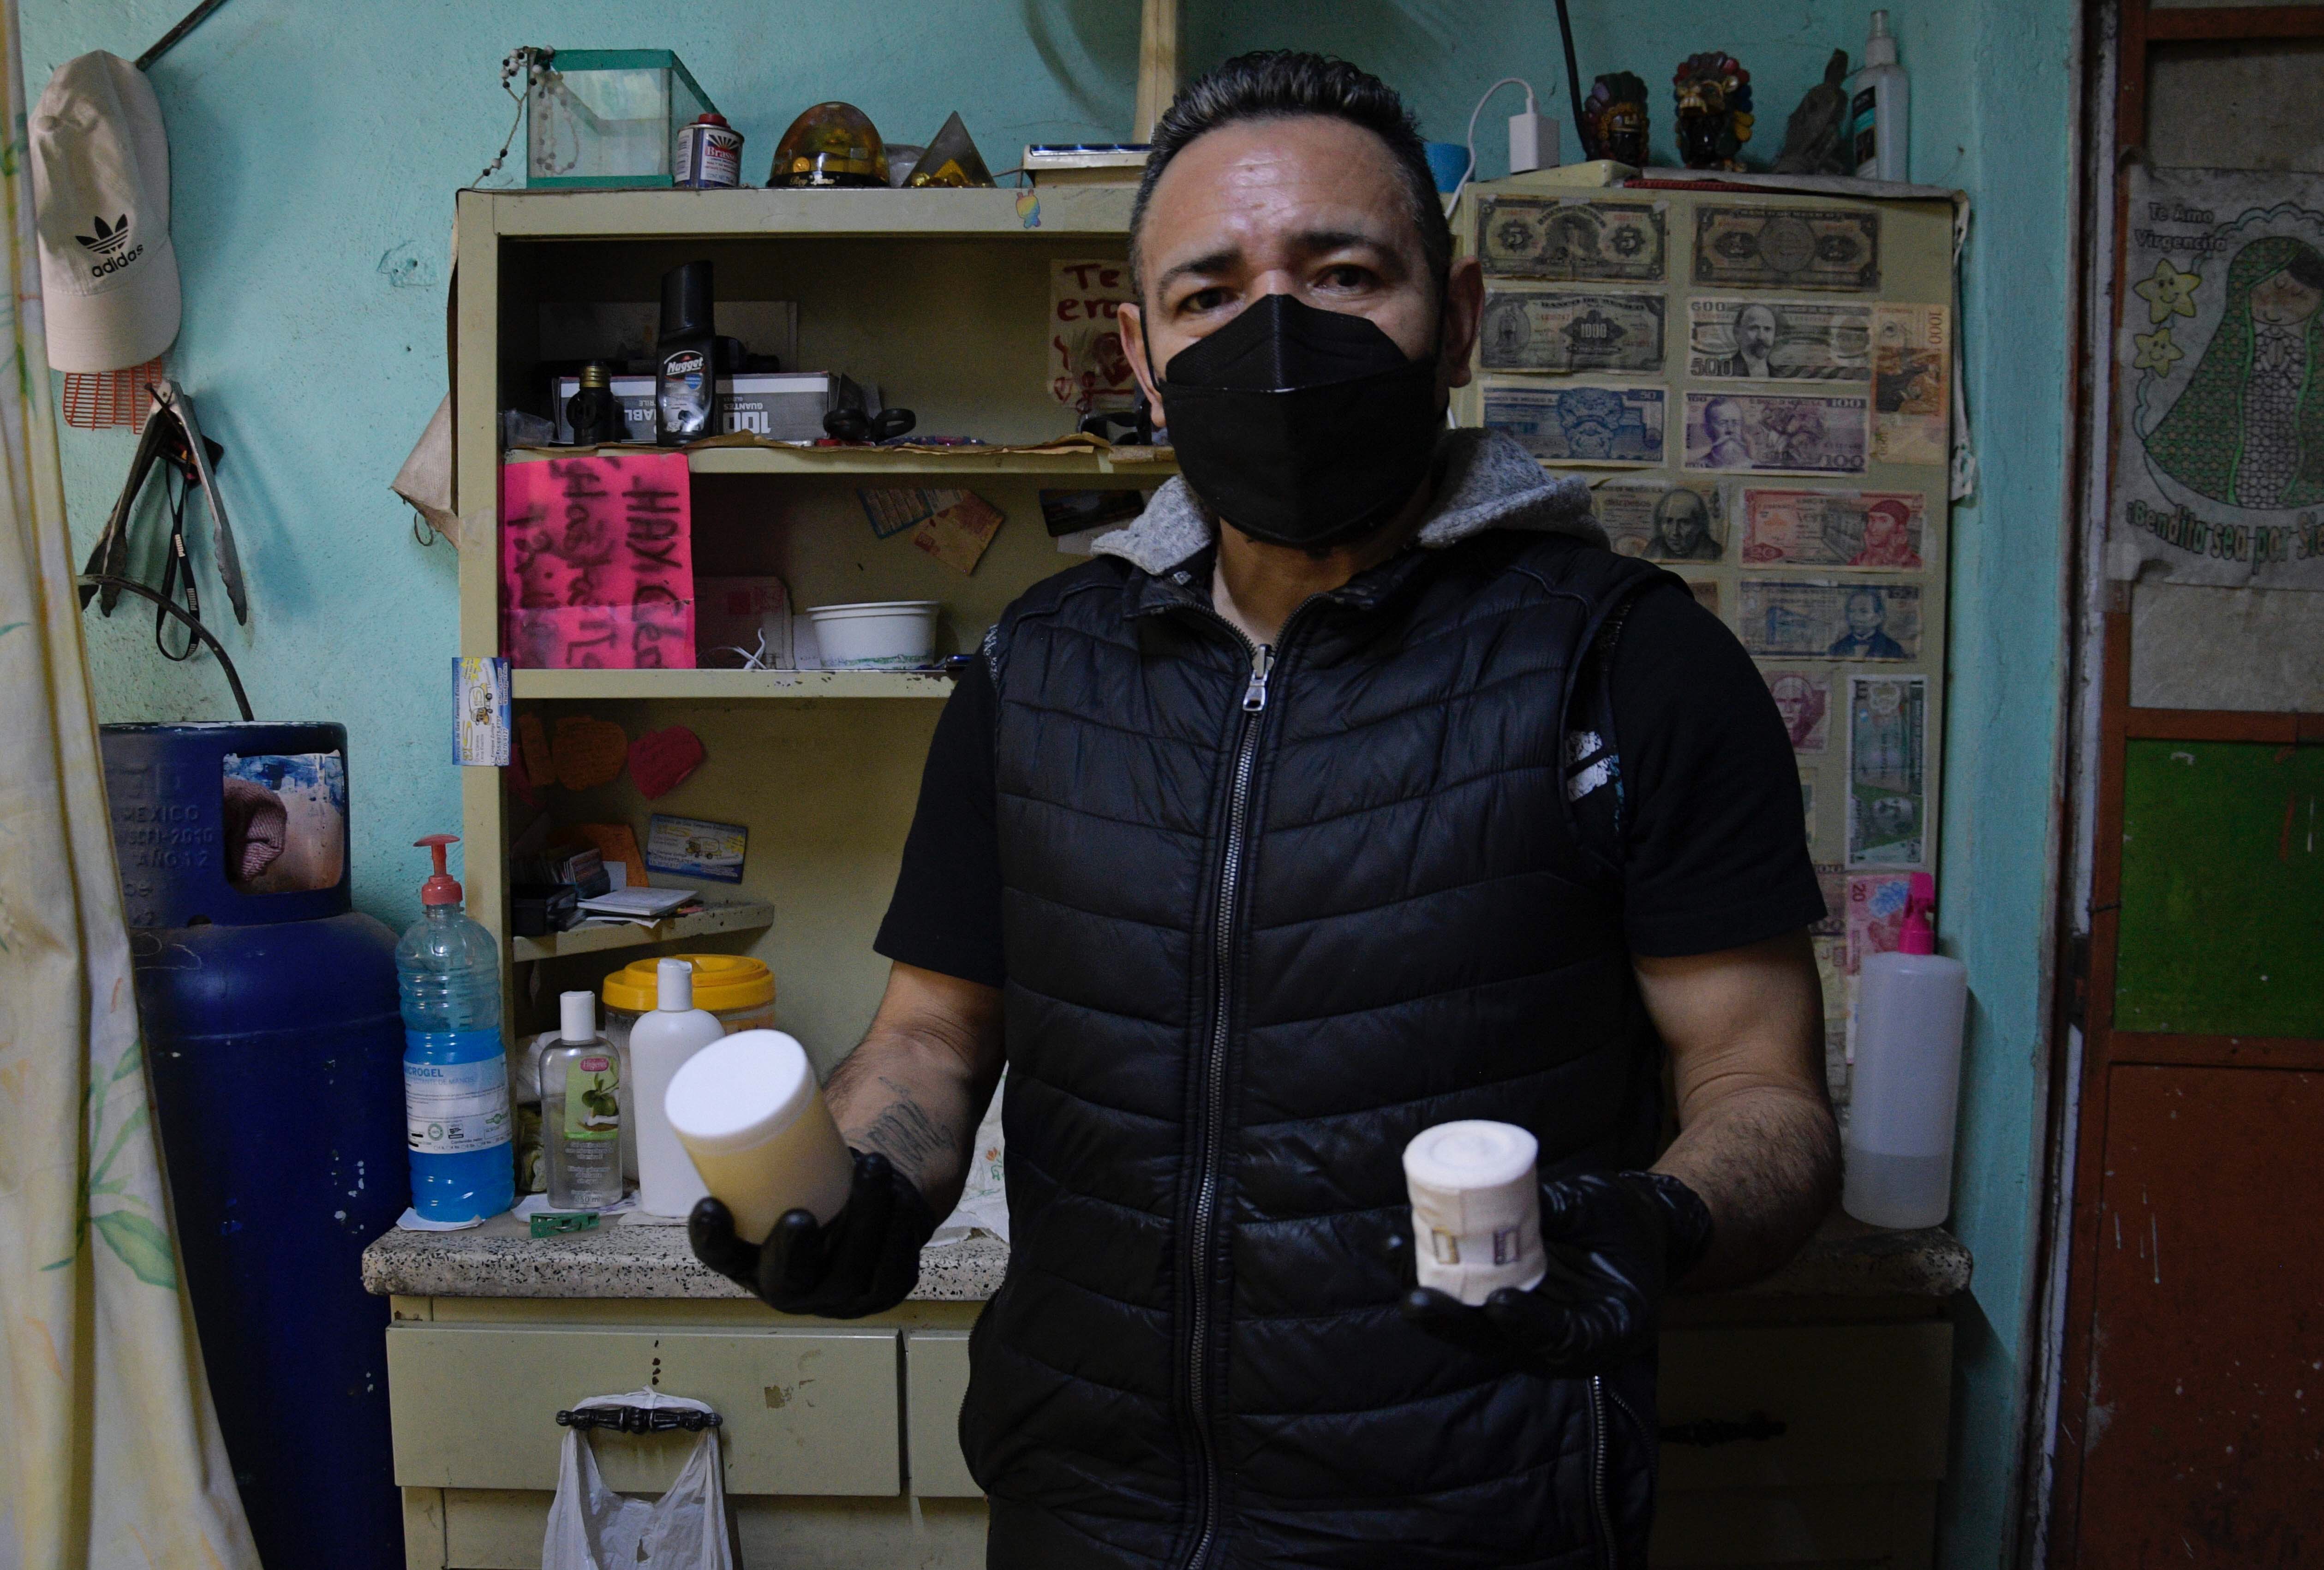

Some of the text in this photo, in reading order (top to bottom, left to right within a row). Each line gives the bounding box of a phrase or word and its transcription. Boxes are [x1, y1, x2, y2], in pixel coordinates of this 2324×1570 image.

[2149, 202, 2214, 223] Te Amo
[2134, 229, 2227, 252] Virgencita
[92, 245, 143, 277] adidas
[1581, 323, 1607, 338] 1000
[667, 357, 704, 374] Nugget
[1691, 358, 1733, 376] 500
[723, 412, 771, 433] 100
[1852, 883, 1866, 902] 20
